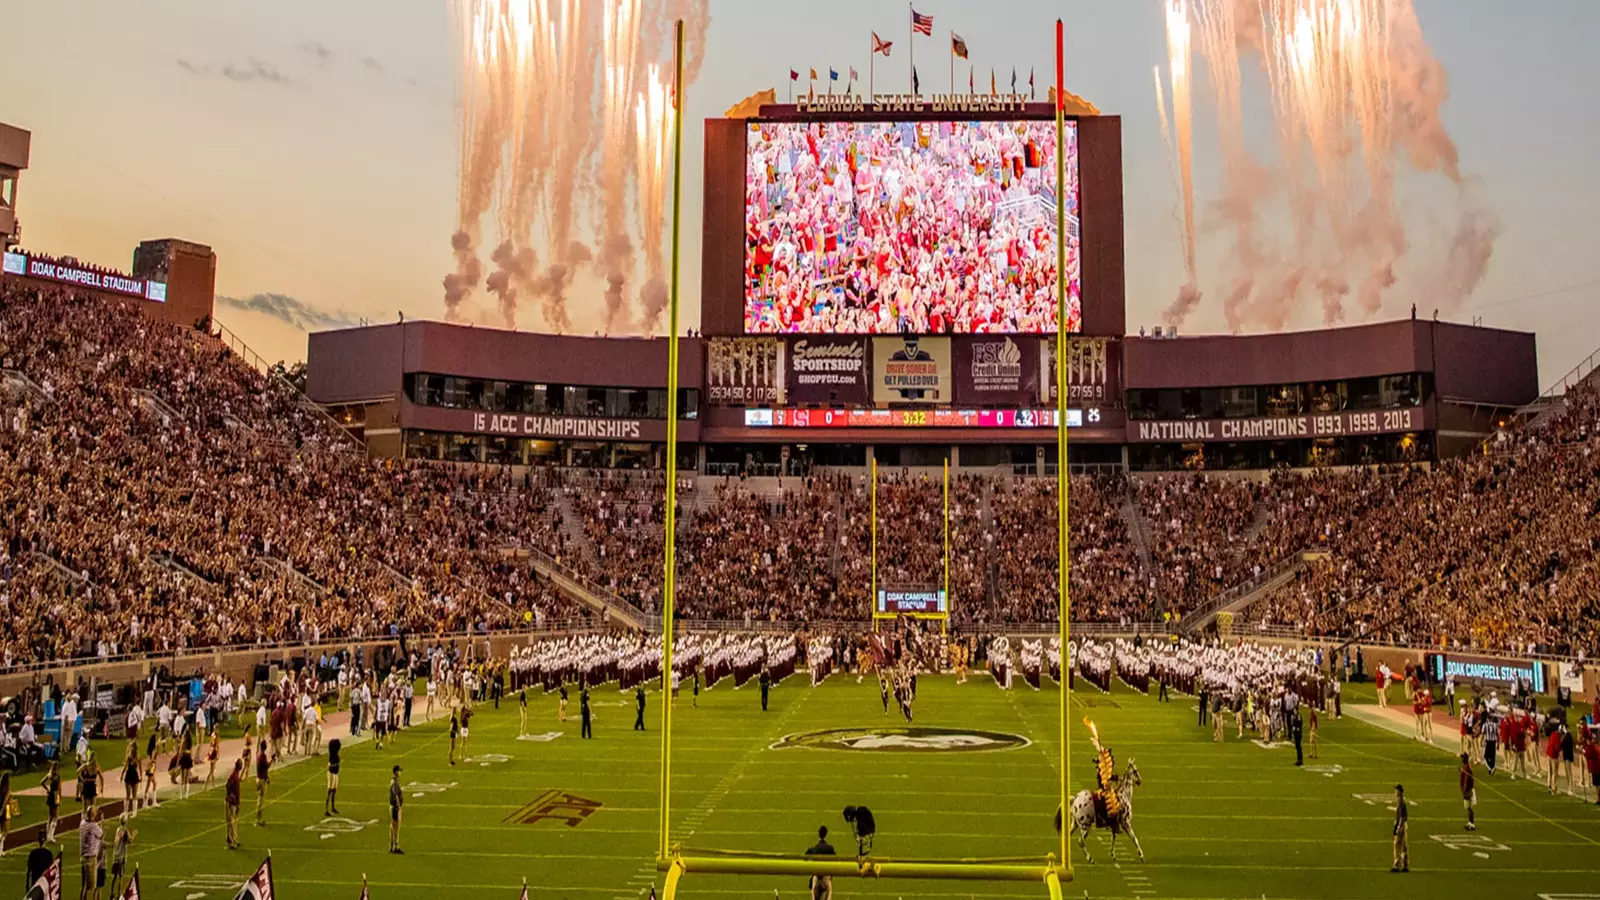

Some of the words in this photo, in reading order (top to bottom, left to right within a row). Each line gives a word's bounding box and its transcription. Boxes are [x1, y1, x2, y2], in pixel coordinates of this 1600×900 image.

[796, 94, 864, 112] FLORIDA
[873, 94, 923, 112] STATE
[932, 94, 1028, 112] UNIVERSITY
[31, 261, 56, 277] DOAK
[56, 266, 101, 287] CAMPBELL
[103, 275, 142, 294] STADIUM
[793, 340, 863, 359] Seminole
[793, 359, 861, 371] SPORTSHOP
[973, 364, 997, 376] Credit
[998, 364, 1020, 376] Union
[922, 376, 938, 385] OVER
[722, 387, 731, 399] 34
[746, 388, 752, 399] 2
[757, 388, 764, 398] 17
[767, 388, 777, 398] 28
[1071, 386, 1080, 397] 27
[1083, 386, 1092, 397] 55
[1096, 386, 1102, 397] 9
[825, 411, 832, 424] 0
[903, 411, 926, 424] 3:32
[996, 411, 1003, 424] 0
[474, 413, 485, 430] 15
[490, 414, 517, 433] ACC
[524, 416, 640, 437] CHAMPIONSHIPS
[1140, 421, 1214, 439] NATIONAL
[1221, 418, 1307, 437] CHAMPIONS
[1384, 411, 1411, 429] 2013
[887, 593, 904, 601] DOAK
[905, 593, 937, 601] CAMPBELL
[1447, 662, 1466, 675] DOAK
[1466, 664, 1500, 681] CAMPBELL
